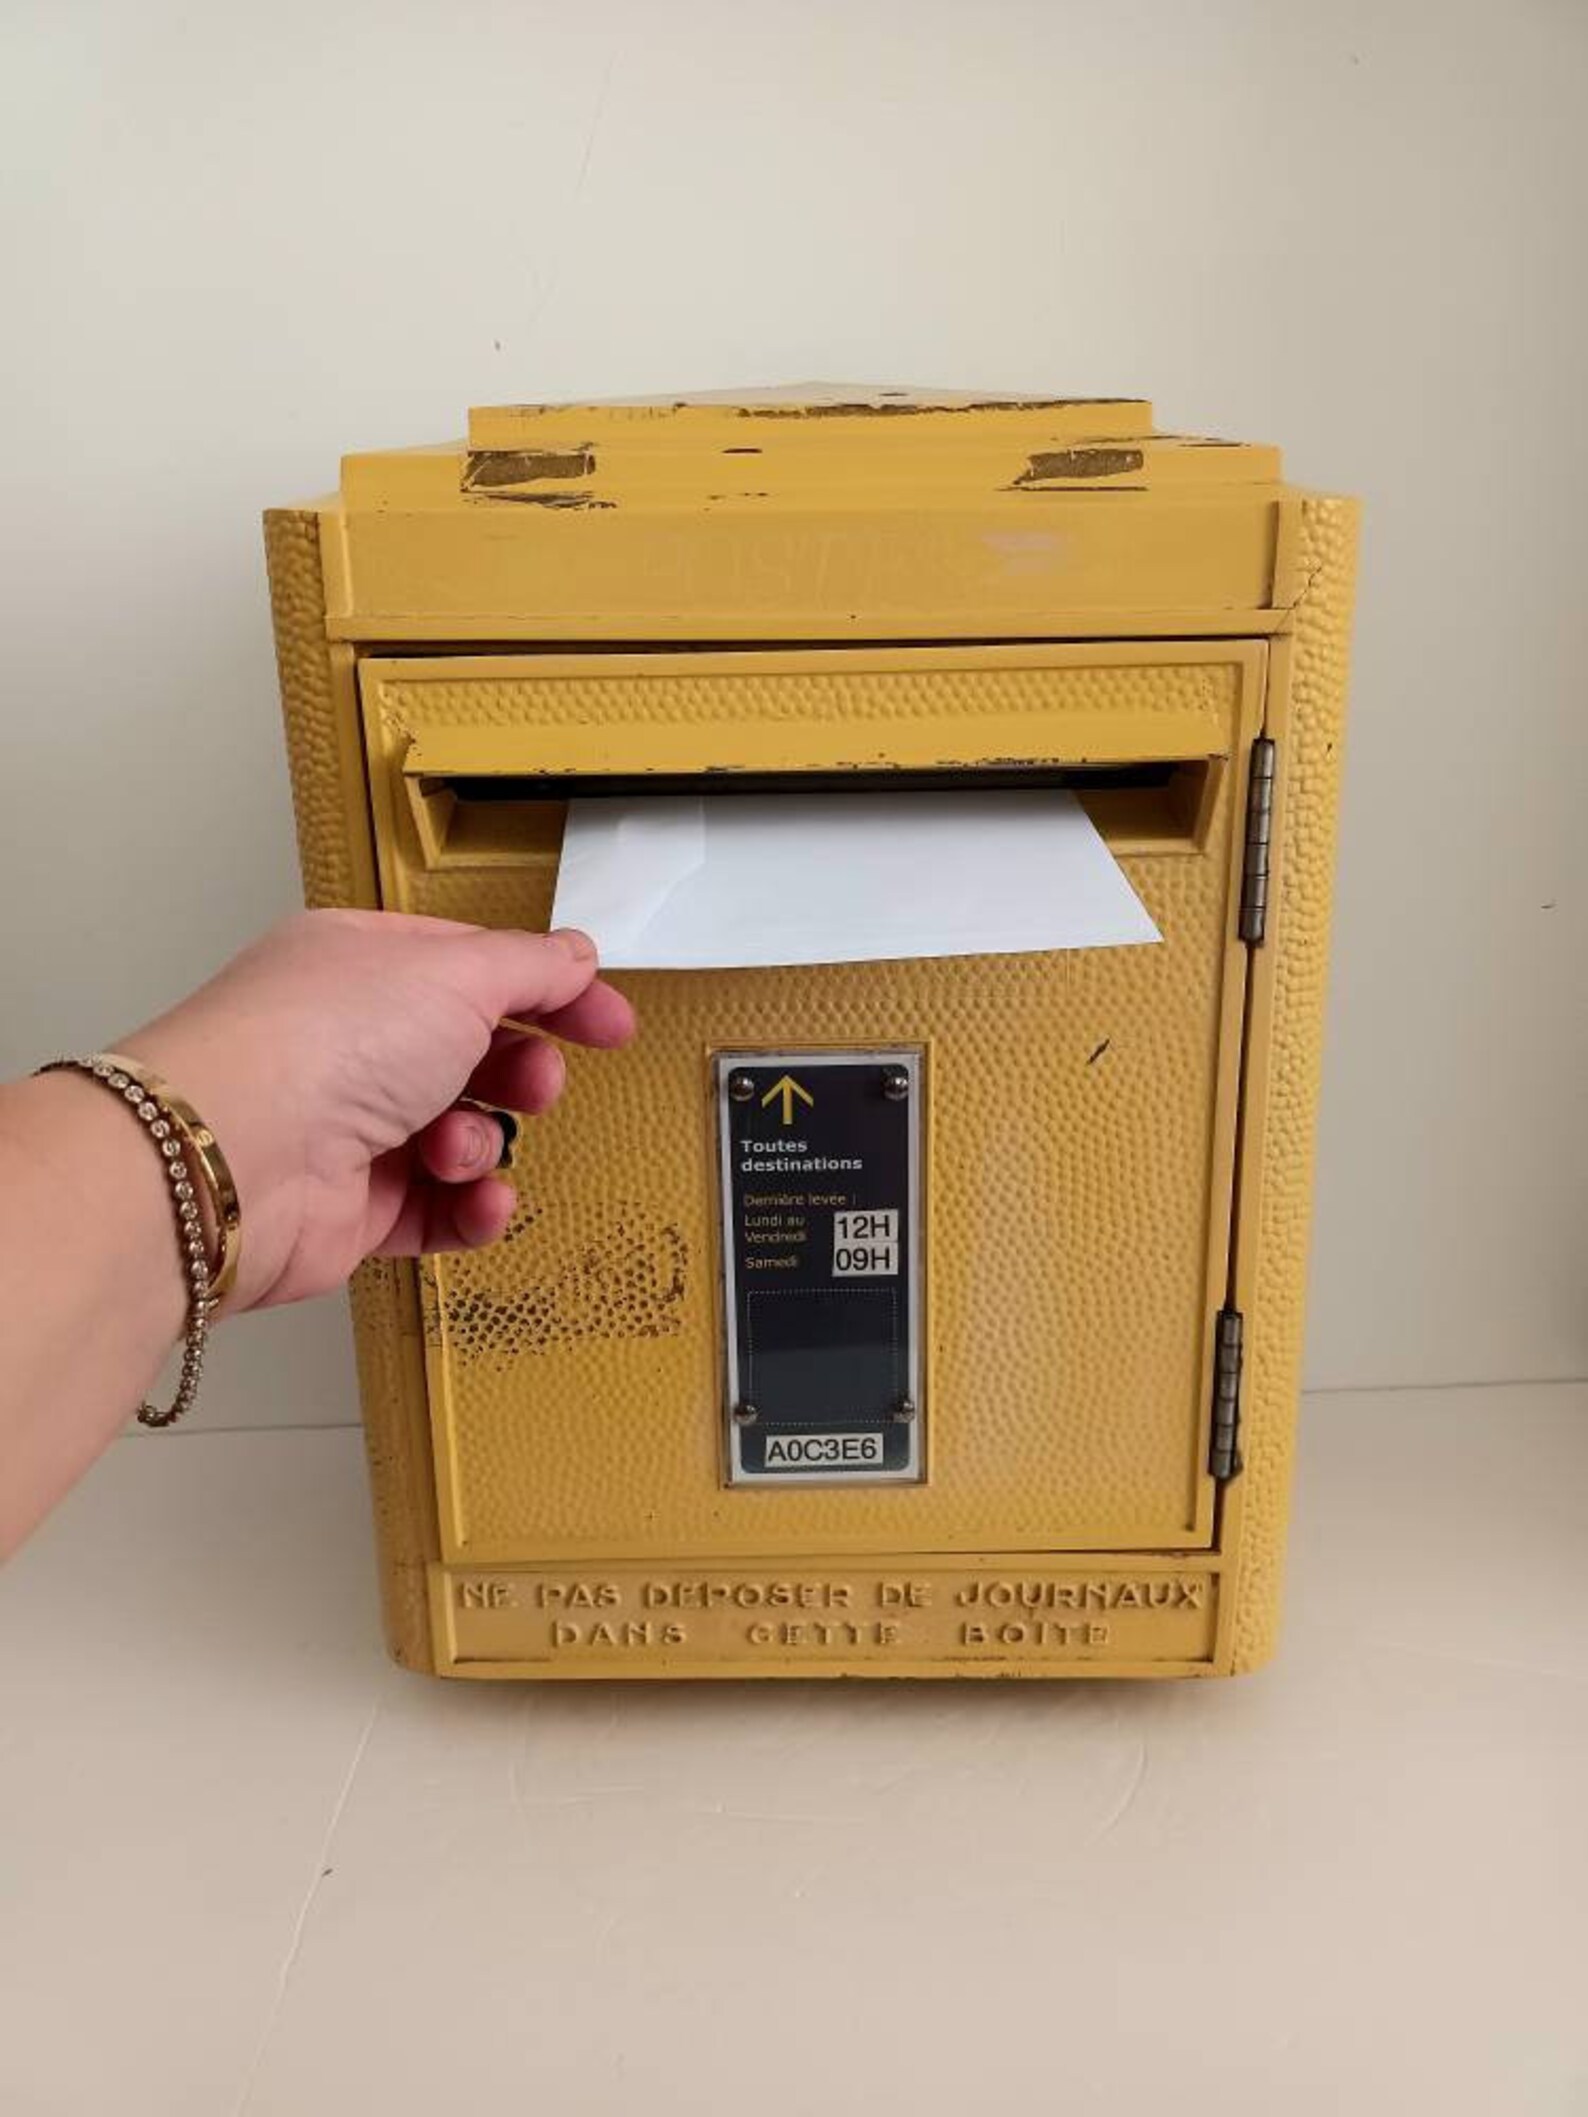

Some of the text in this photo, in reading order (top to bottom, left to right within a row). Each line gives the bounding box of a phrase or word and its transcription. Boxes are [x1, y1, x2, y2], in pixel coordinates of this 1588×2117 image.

[740, 1139, 808, 1153] Toutes
[740, 1157, 863, 1172] destinations
[744, 1214, 805, 1227] Lundi au
[837, 1214, 890, 1240] 12H
[744, 1231, 807, 1244] Vendredi
[745, 1255, 798, 1269] Samedi
[835, 1247, 890, 1271] 09H
[768, 1437, 878, 1462] A0C3E6
[460, 1580, 1203, 1609] NE PAS DEPOSER DE JOURNAUX
[551, 1619, 1111, 1647] DANS CETTE BOITE
